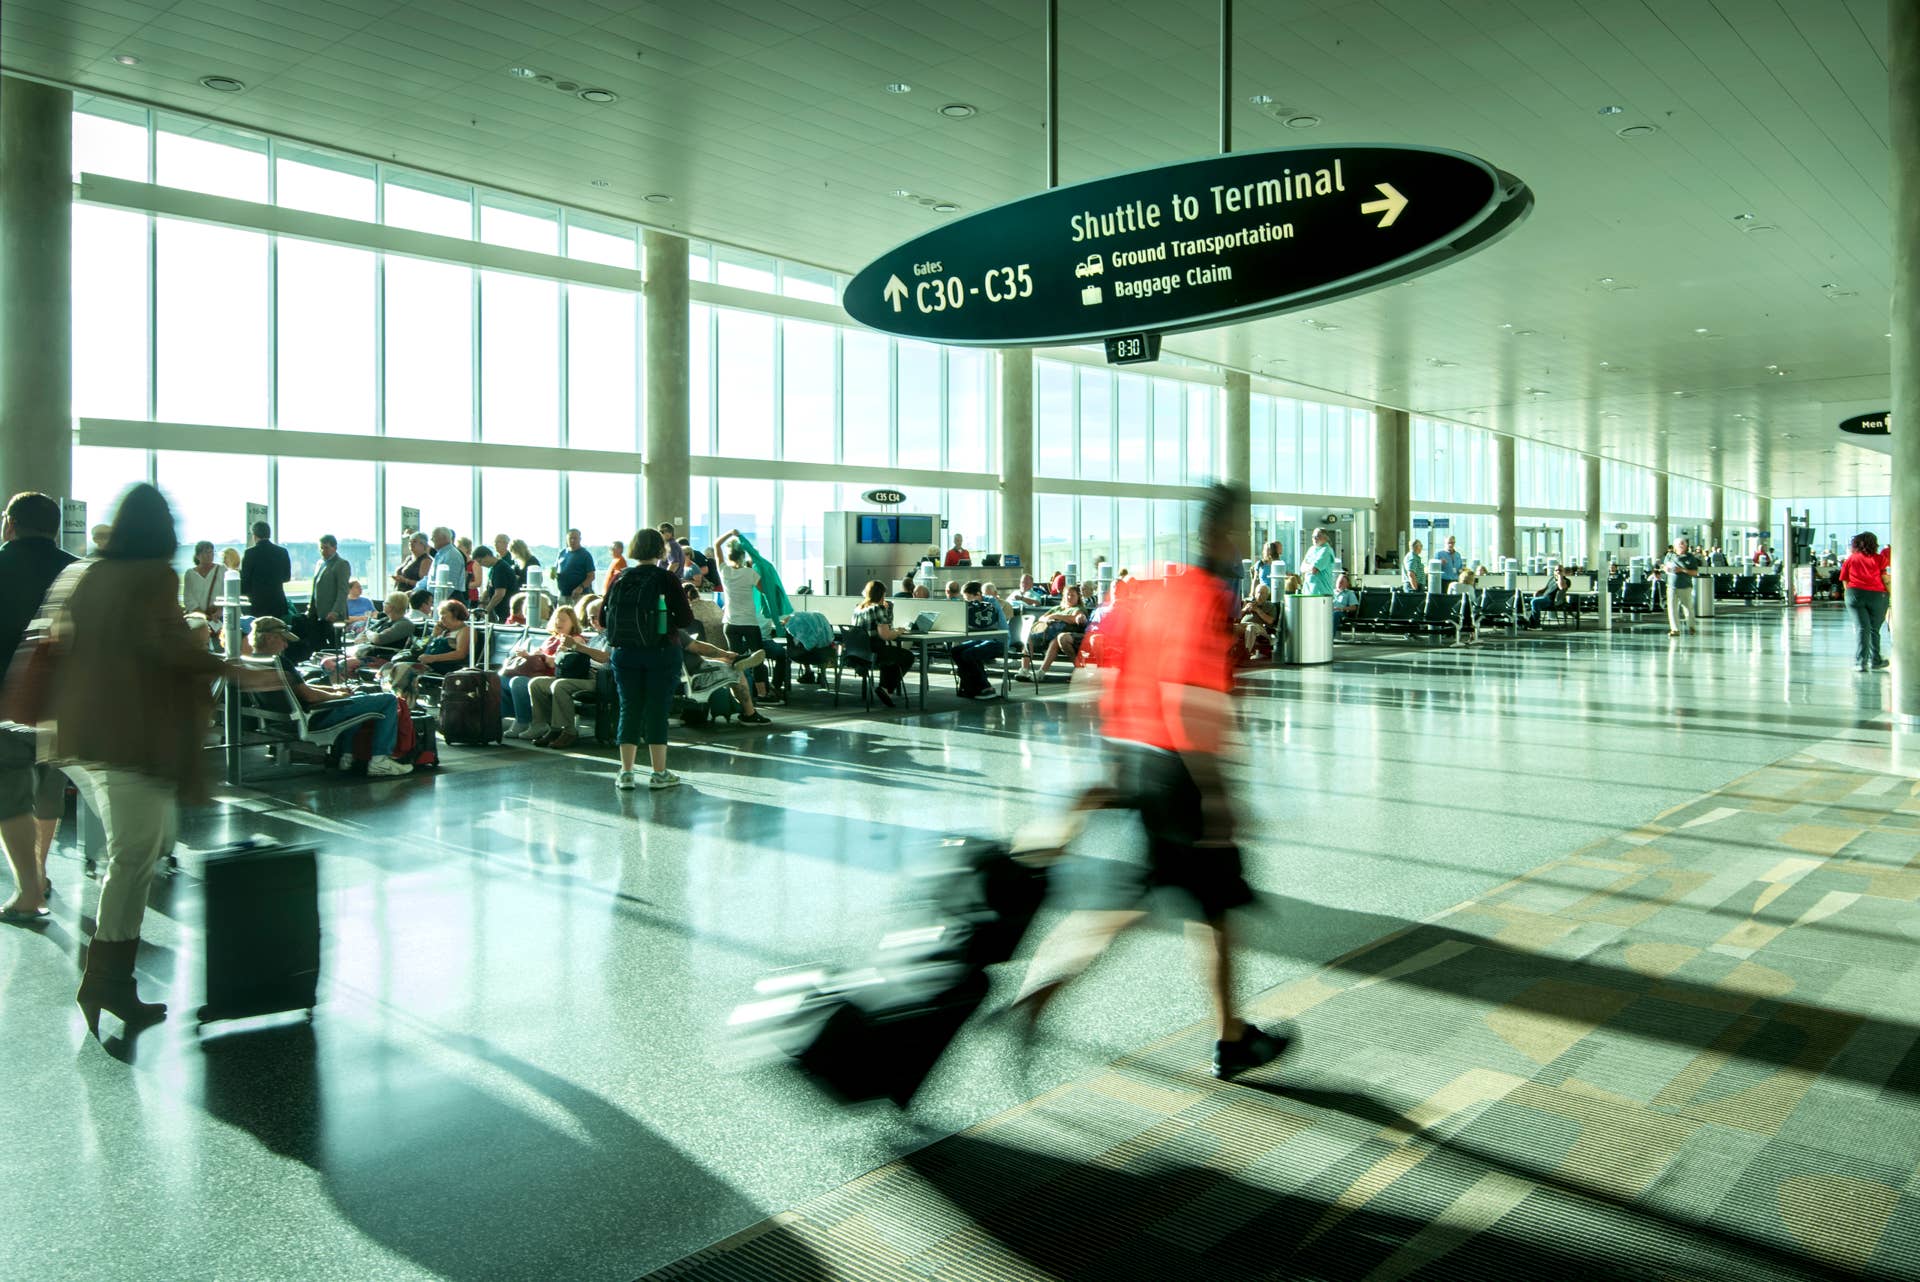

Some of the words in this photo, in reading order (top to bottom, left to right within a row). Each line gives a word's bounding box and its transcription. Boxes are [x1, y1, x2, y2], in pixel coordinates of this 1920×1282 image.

[1070, 200, 1162, 243] Shuttle
[1171, 194, 1199, 222] to
[1210, 158, 1346, 216] Terminal
[1111, 242, 1167, 269] Ground
[1171, 222, 1295, 259] Transportation
[913, 260, 943, 277] Gates
[916, 277, 964, 314] C30
[984, 263, 1033, 303] C35
[1114, 275, 1181, 300] Baggage
[1186, 266, 1232, 287] Claim
[1117, 338, 1140, 357] 8:30
[1861, 420, 1883, 429] Men
[875, 492, 887, 502] C35
